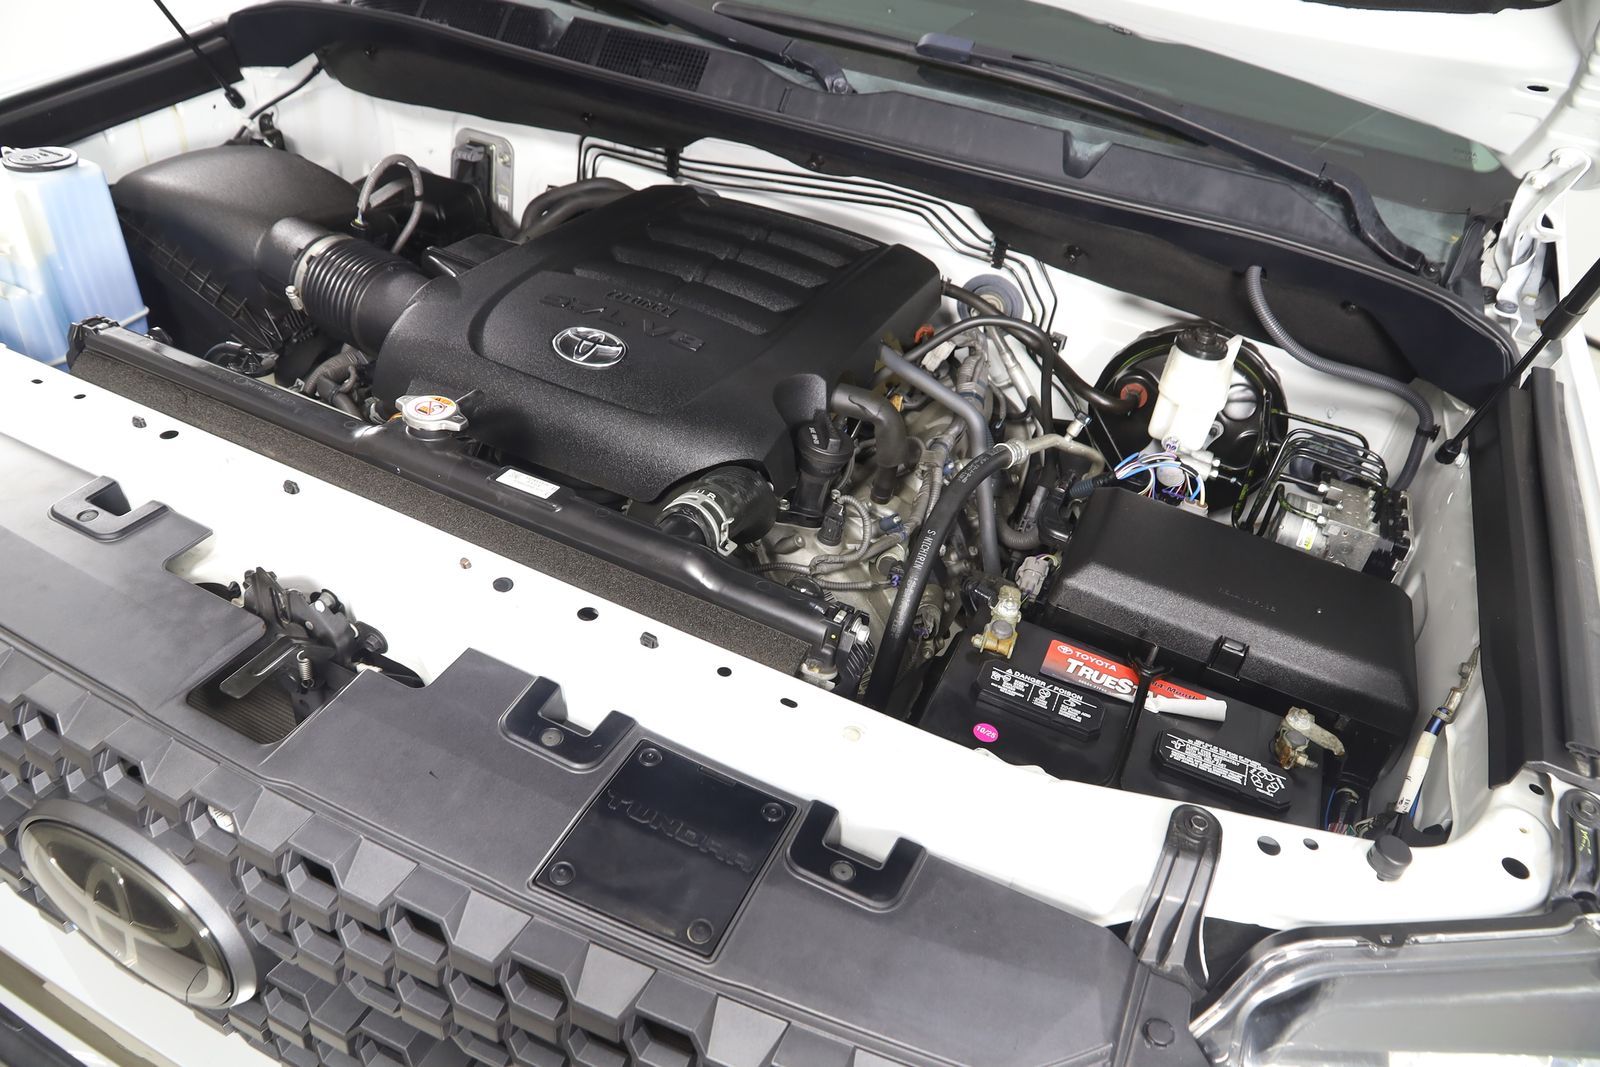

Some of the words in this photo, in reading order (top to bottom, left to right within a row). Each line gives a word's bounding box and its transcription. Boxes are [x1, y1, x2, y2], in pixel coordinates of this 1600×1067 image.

[1074, 651, 1117, 672] TOYOTA
[1014, 671, 1046, 687] DANGER
[1053, 686, 1083, 701] POISON
[976, 725, 997, 739] 10/25
